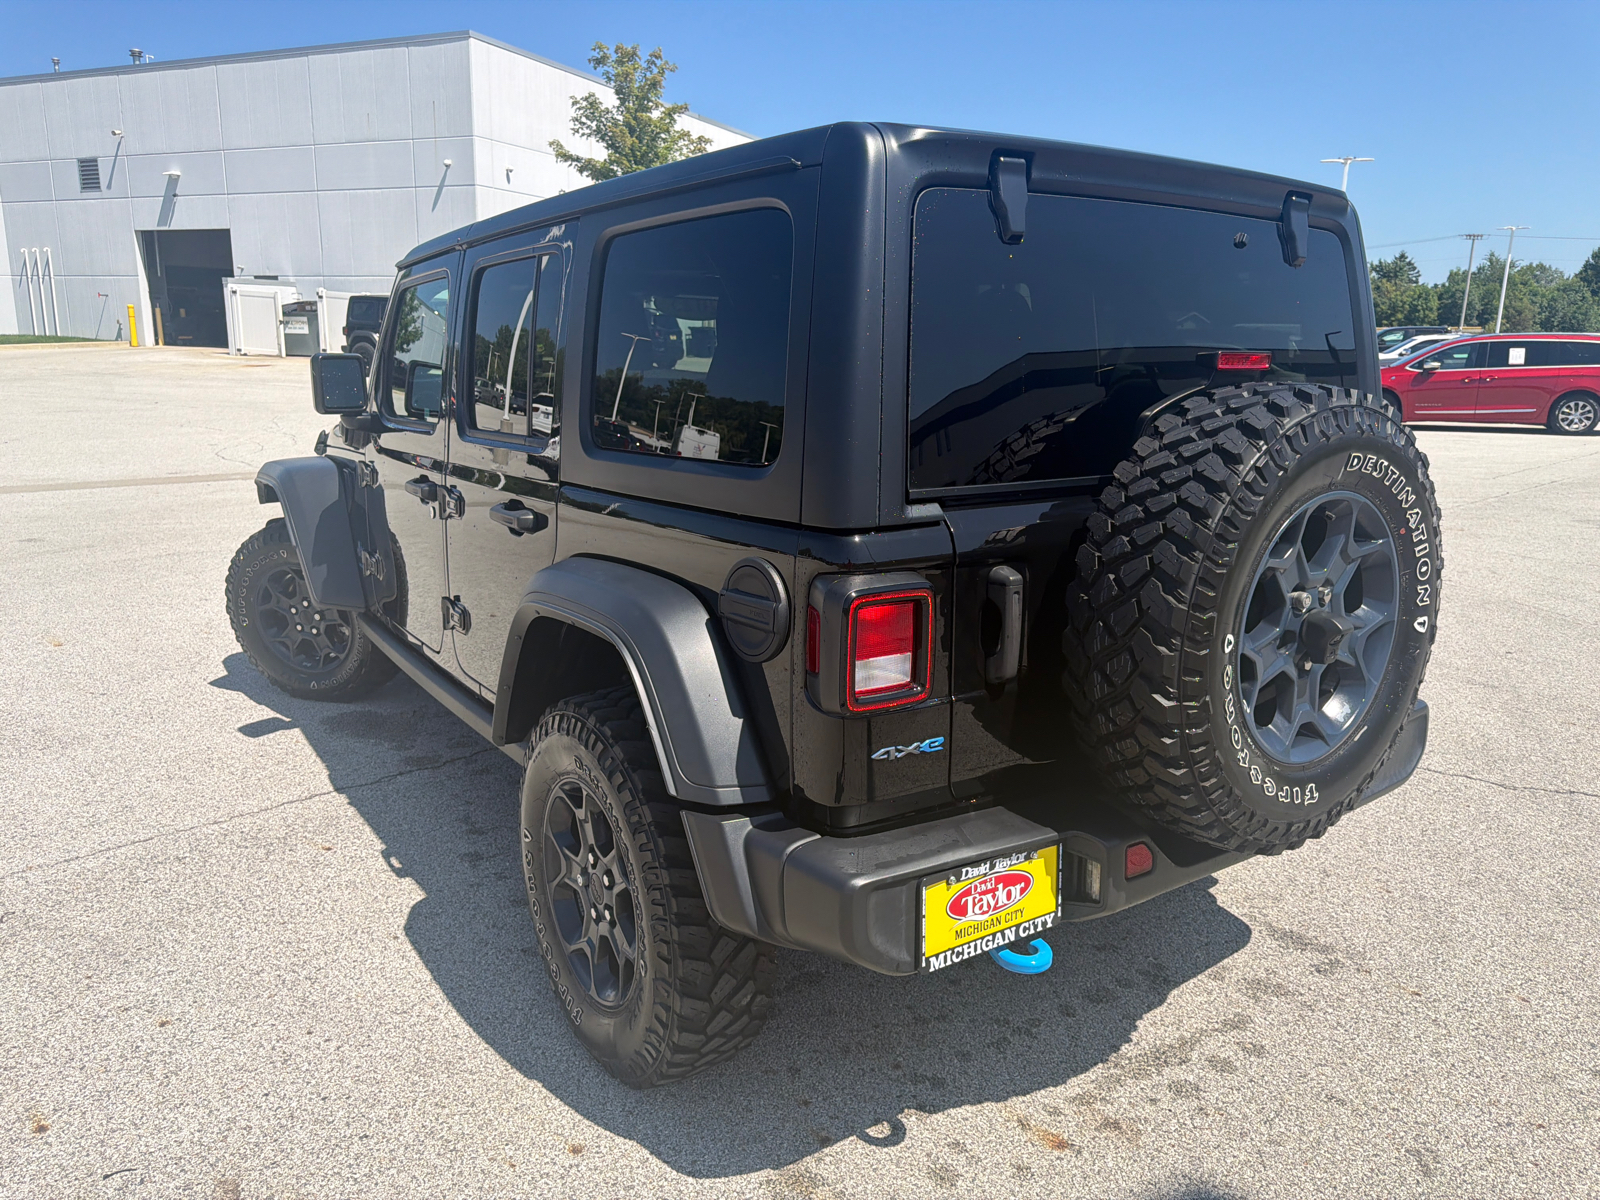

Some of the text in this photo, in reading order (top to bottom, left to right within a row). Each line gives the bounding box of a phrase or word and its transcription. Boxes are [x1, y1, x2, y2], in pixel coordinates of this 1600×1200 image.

[1346, 452, 1431, 607] DESTINATION
[960, 851, 1027, 881] David Taylor
[960, 881, 1026, 918] Taylor
[971, 877, 996, 895] David
[954, 907, 1026, 941] MICHIGAN CITY
[929, 927, 1017, 973] MICHIGAN
[1018, 912, 1056, 938] CITY
